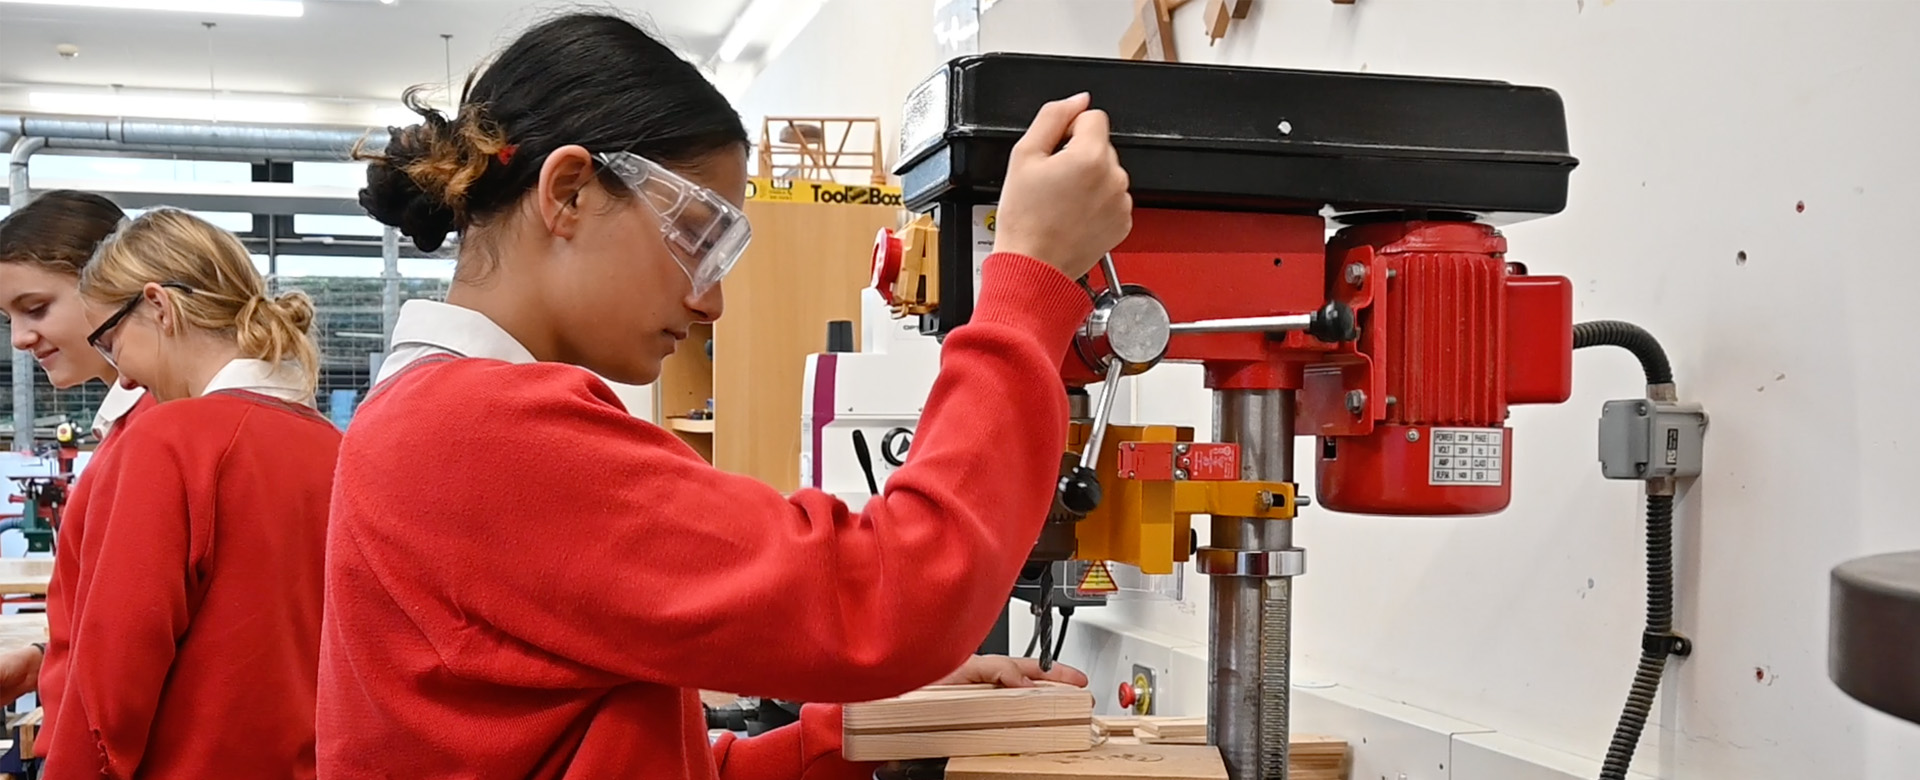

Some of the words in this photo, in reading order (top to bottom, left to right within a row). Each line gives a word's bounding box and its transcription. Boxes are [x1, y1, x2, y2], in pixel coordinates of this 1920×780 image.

[811, 185, 848, 203] Tool
[869, 187, 902, 206] Box
[1436, 433, 1453, 441] POWER
